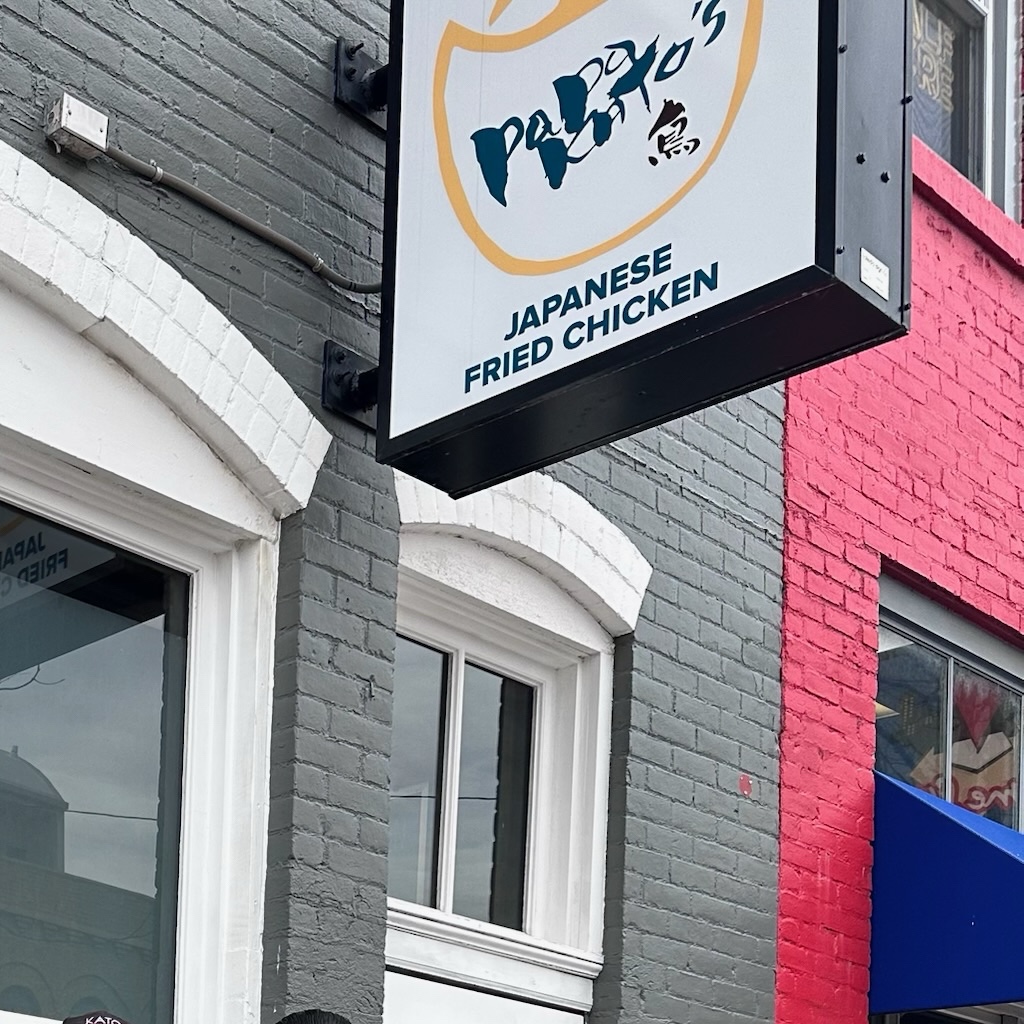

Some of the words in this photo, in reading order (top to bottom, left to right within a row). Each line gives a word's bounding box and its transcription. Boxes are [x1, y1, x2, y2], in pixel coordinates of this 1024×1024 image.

[464, 335, 554, 394] FRIED
[562, 262, 719, 350] CHICKEN
[504, 243, 672, 341] JAPANESE
